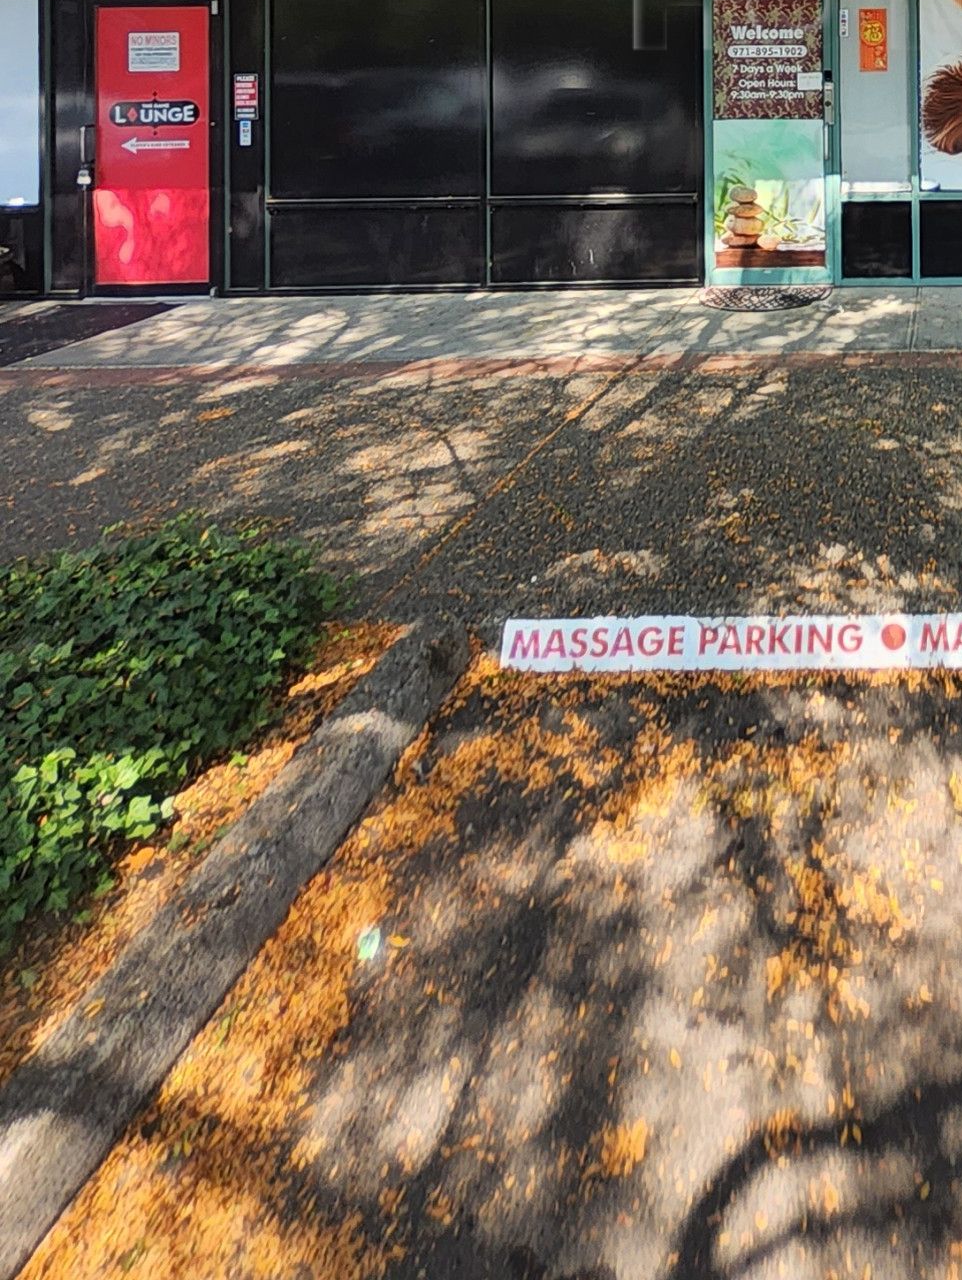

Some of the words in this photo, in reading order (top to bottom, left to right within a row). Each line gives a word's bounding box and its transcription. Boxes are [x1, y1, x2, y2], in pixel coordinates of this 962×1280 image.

[731, 25, 804, 40] Welcome
[131, 35, 144, 46] NO
[145, 34, 178, 46] MINORS
[732, 47, 803, 56] 971-895-1902
[740, 65, 764, 74] Days
[774, 64, 803, 73] Week
[738, 79, 766, 89] Open
[509, 625, 685, 659] MASSAGE
[698, 623, 864, 656] PARKING
